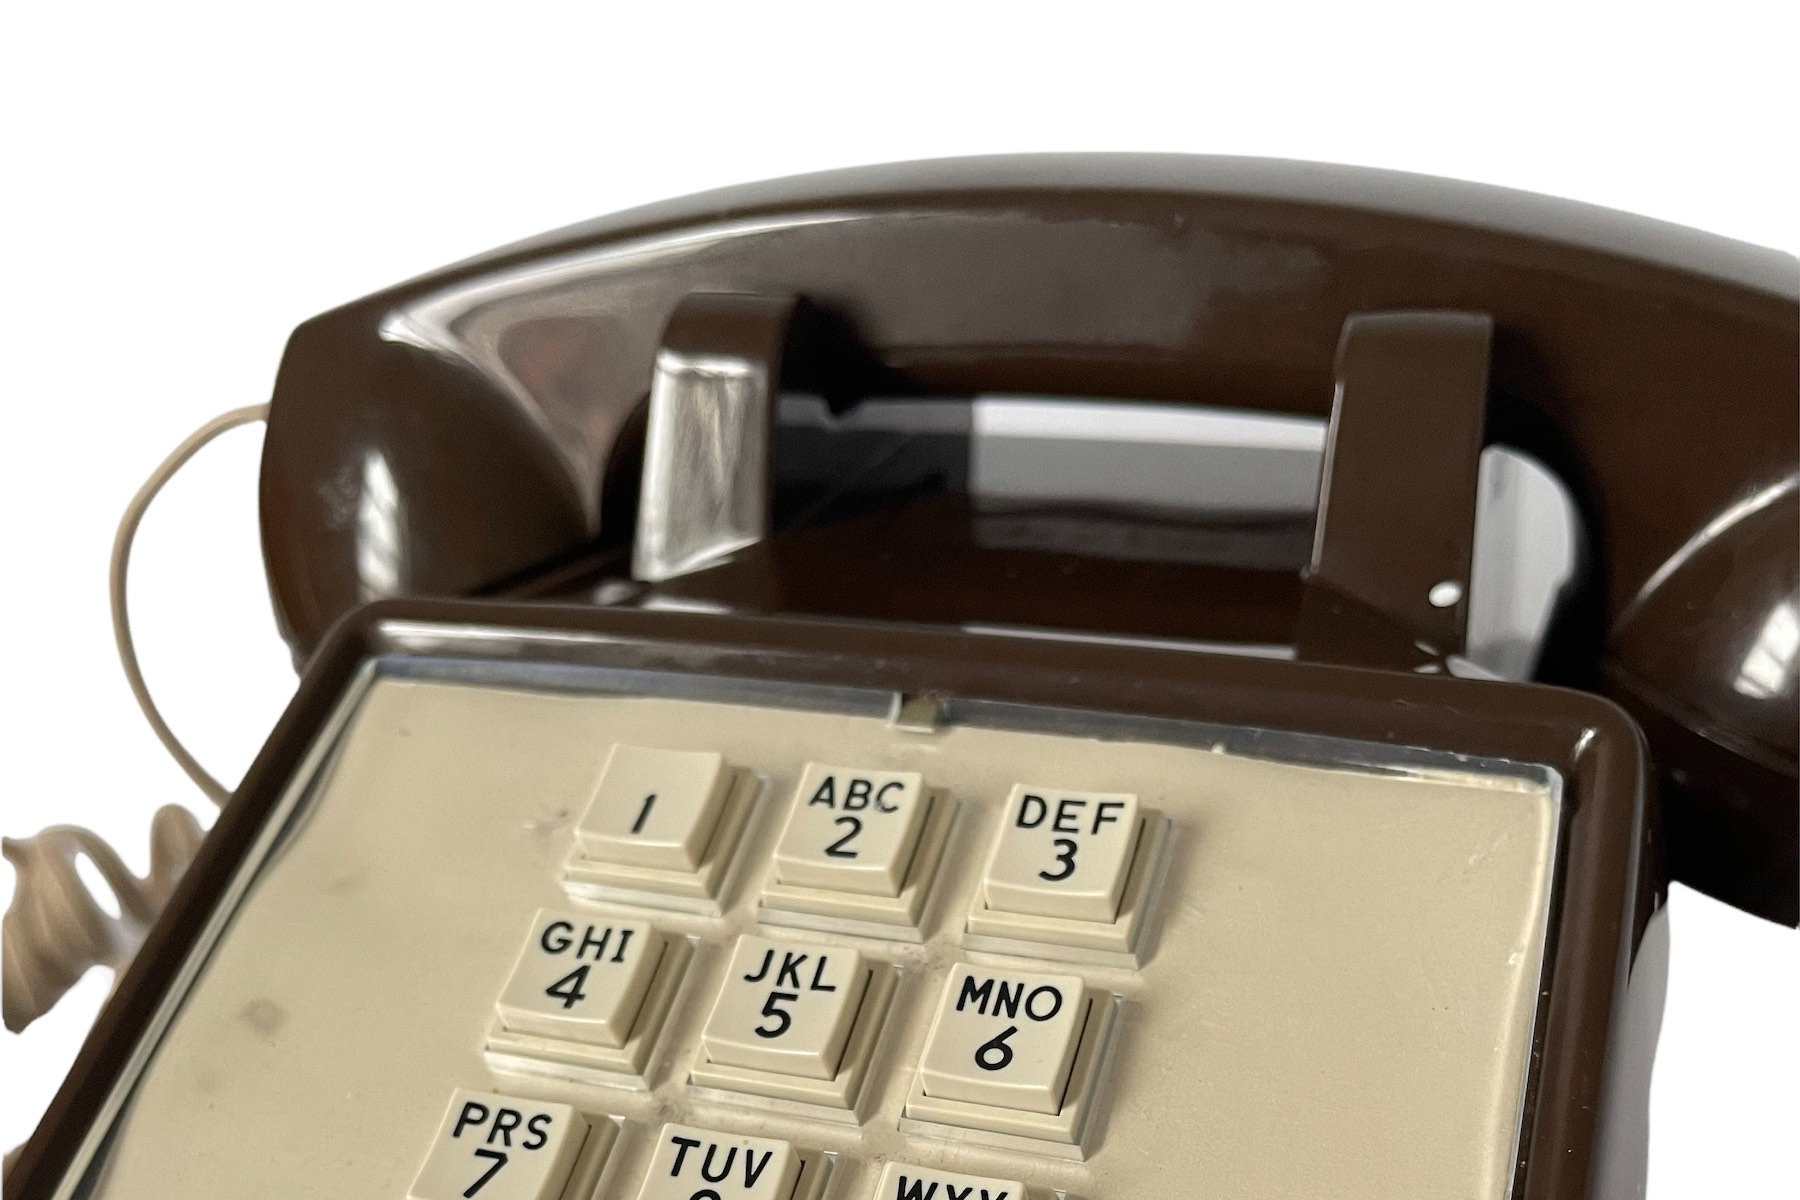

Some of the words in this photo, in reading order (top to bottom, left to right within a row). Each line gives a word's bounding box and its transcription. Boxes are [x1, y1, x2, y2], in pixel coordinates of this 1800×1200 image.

[631, 793, 657, 834] 1
[809, 775, 906, 815] ABC
[1015, 793, 1126, 836] DEF
[823, 815, 863, 859] 2
[1038, 837, 1079, 882] 3
[540, 920, 634, 964] GHI
[544, 964, 592, 1010] 4
[742, 948, 837, 993] JKL
[753, 990, 800, 1040] 5
[955, 974, 1064, 1023] MNO
[973, 1024, 1019, 1072] 6
[451, 1100, 553, 1152] PRS
[461, 1147, 509, 1200] 7
[669, 1135, 774, 1190] TUV
